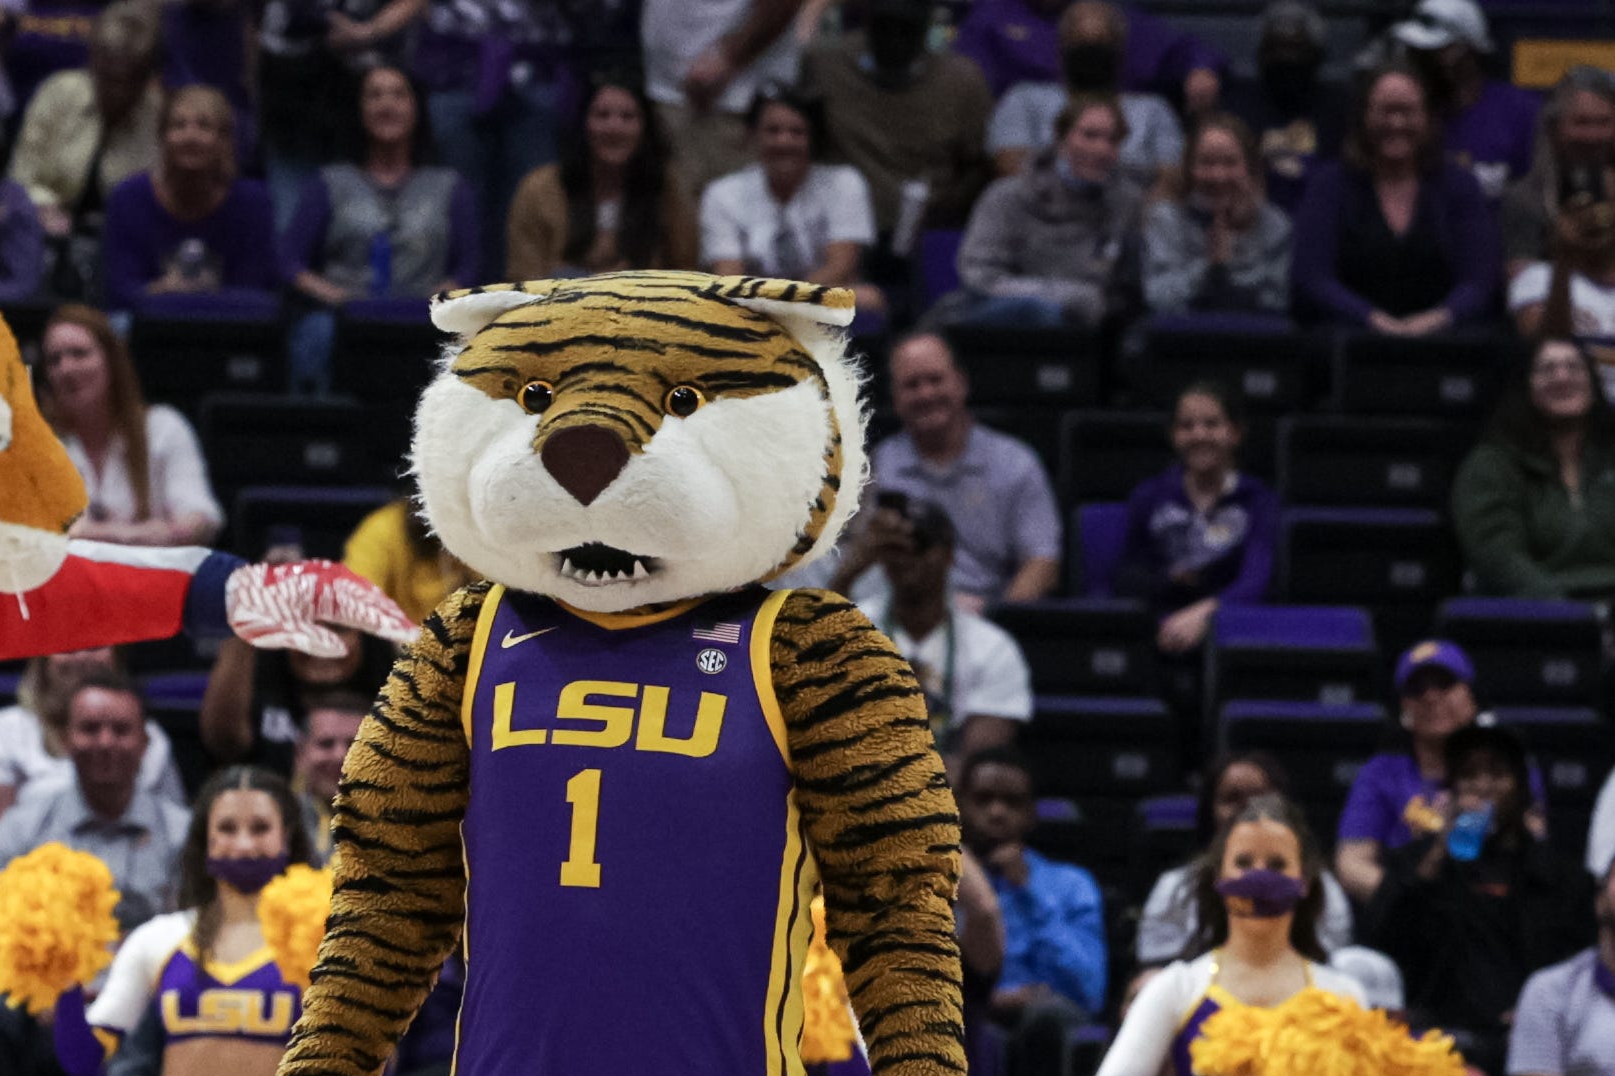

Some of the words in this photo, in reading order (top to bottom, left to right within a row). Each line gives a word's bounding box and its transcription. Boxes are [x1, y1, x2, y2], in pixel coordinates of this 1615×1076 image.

[700, 650, 724, 672] SEC
[491, 680, 728, 758] LSU
[560, 768, 602, 888] 1
[161, 989, 293, 1036] LSU
